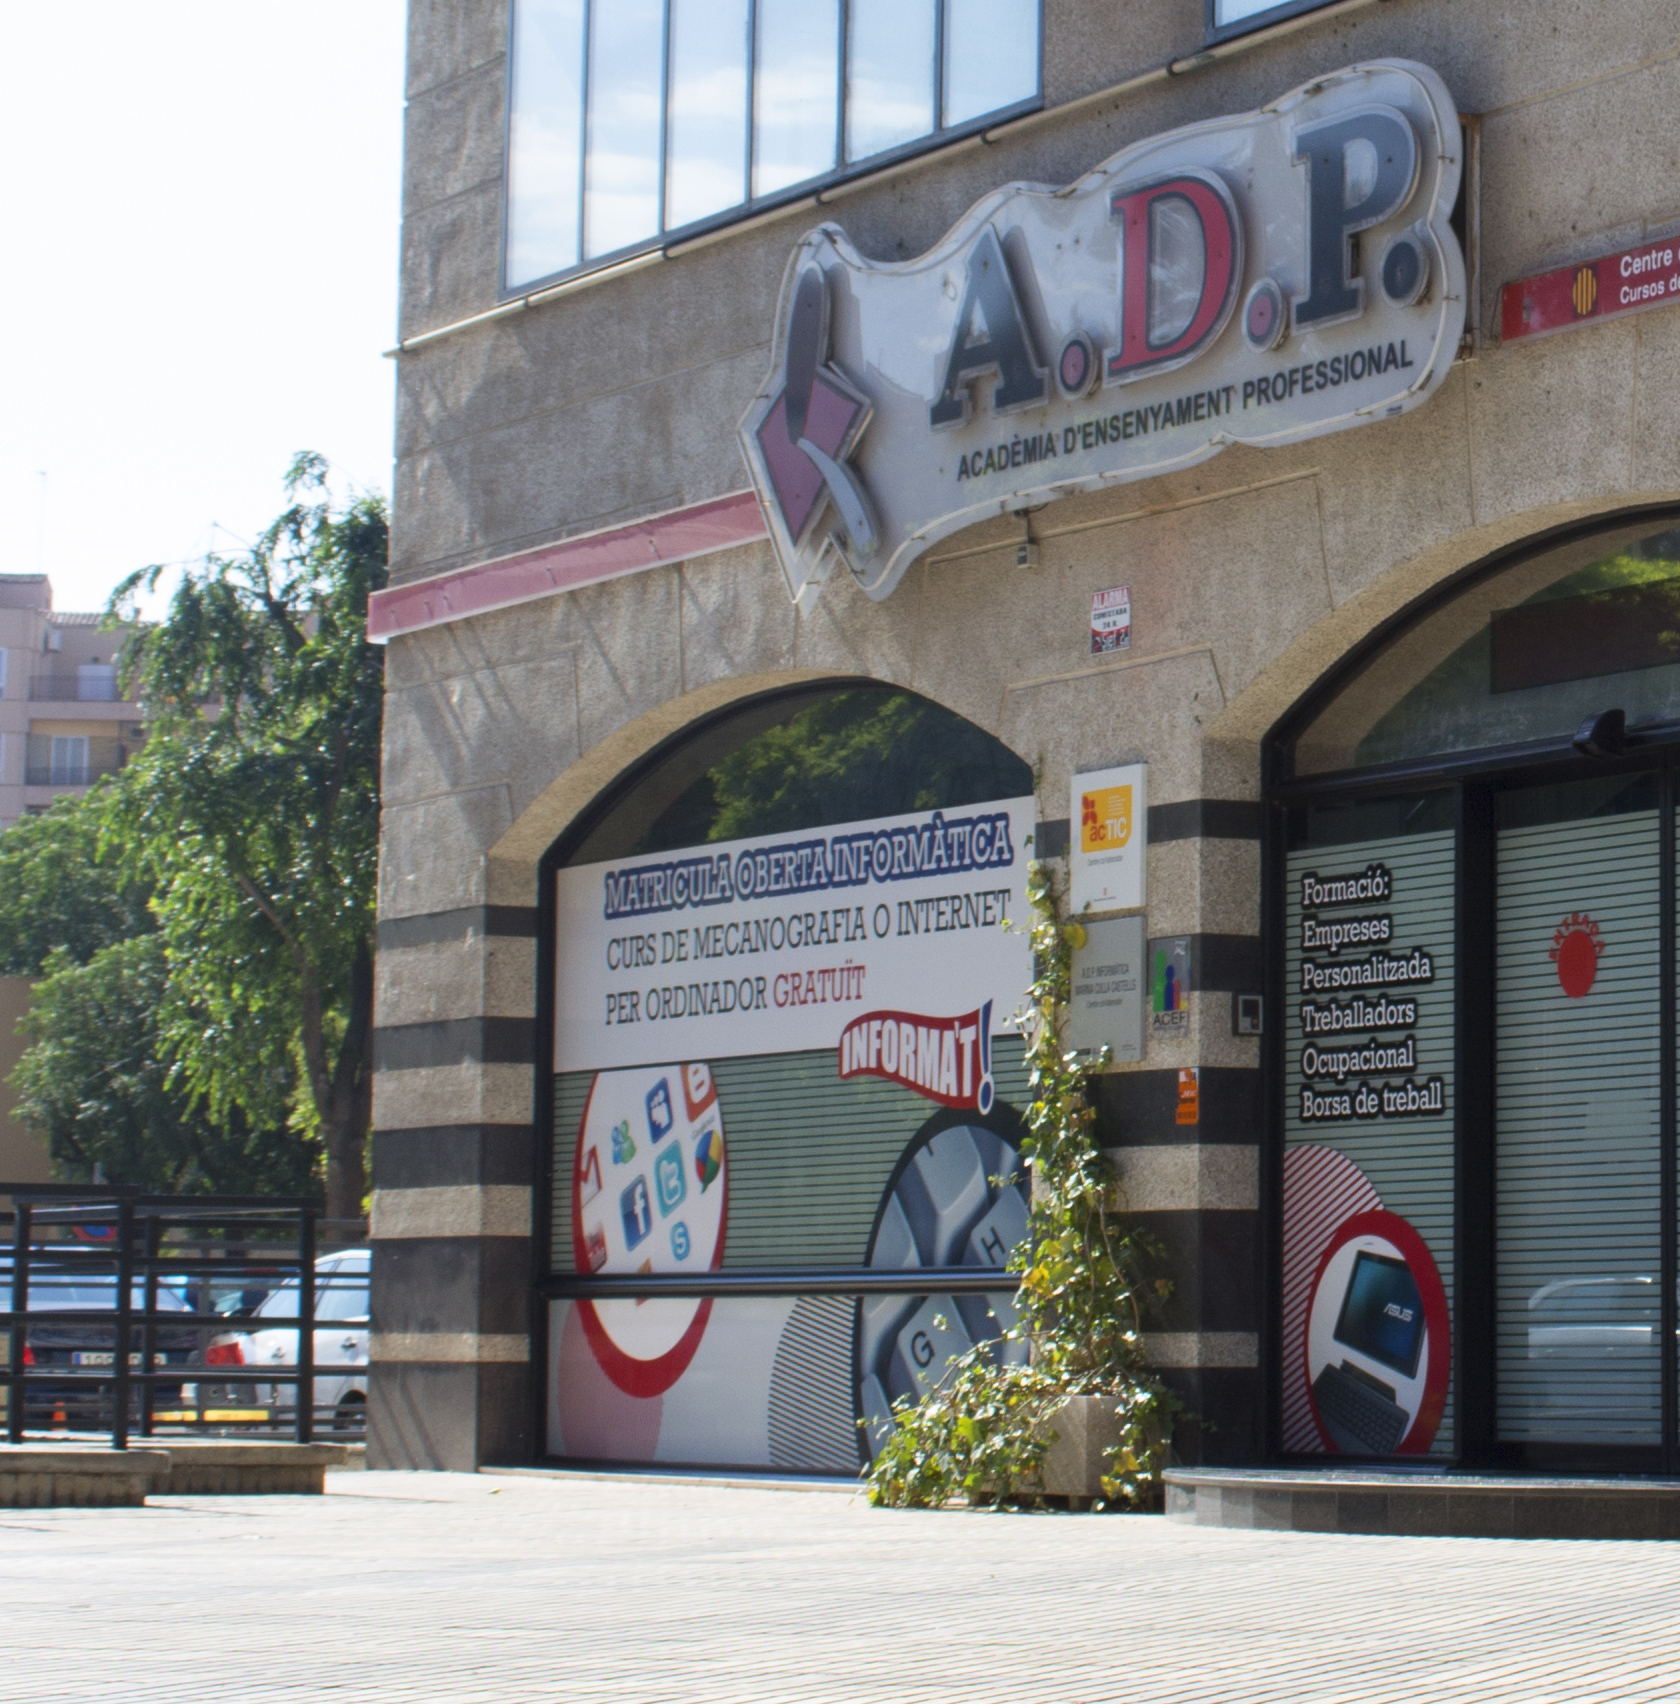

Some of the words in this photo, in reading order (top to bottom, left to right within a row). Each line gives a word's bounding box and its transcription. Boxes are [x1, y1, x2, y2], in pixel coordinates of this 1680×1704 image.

[1620, 249, 1672, 277] Centre
[1620, 280, 1665, 304] Cursos
[957, 433, 1057, 482] ACADÈMIA
[1063, 385, 1235, 454] D'ENSENYAMENT
[1242, 340, 1413, 409] PROFESSIONAL
[604, 857, 733, 917] MATRICULA
[736, 844, 829, 898] OBERTA
[832, 816, 1012, 883] INFORMÀTICA
[1303, 869, 1389, 905] Formació:
[607, 934, 656, 970] CURS
[661, 929, 689, 963] DE
[693, 906, 867, 961] MECANOGRAFIA
[873, 903, 890, 938] O
[897, 888, 1011, 936] INTERNET
[1303, 919, 1390, 951] Empreses
[1303, 952, 1431, 989] Personalitzada
[605, 990, 641, 1025] PER
[645, 976, 767, 1021] ORDINADOR
[773, 958, 865, 1008] GRATUÏT
[1153, 1011, 1186, 1026] ACEF
[1302, 998, 1415, 1032] Treballadors
[1303, 1040, 1414, 1079] Ocupacional
[1302, 1091, 1351, 1117] Borsa
[1355, 1087, 1379, 1114] de
[1383, 1082, 1442, 1112] treball
[1383, 1302, 1414, 1323] ASUS
